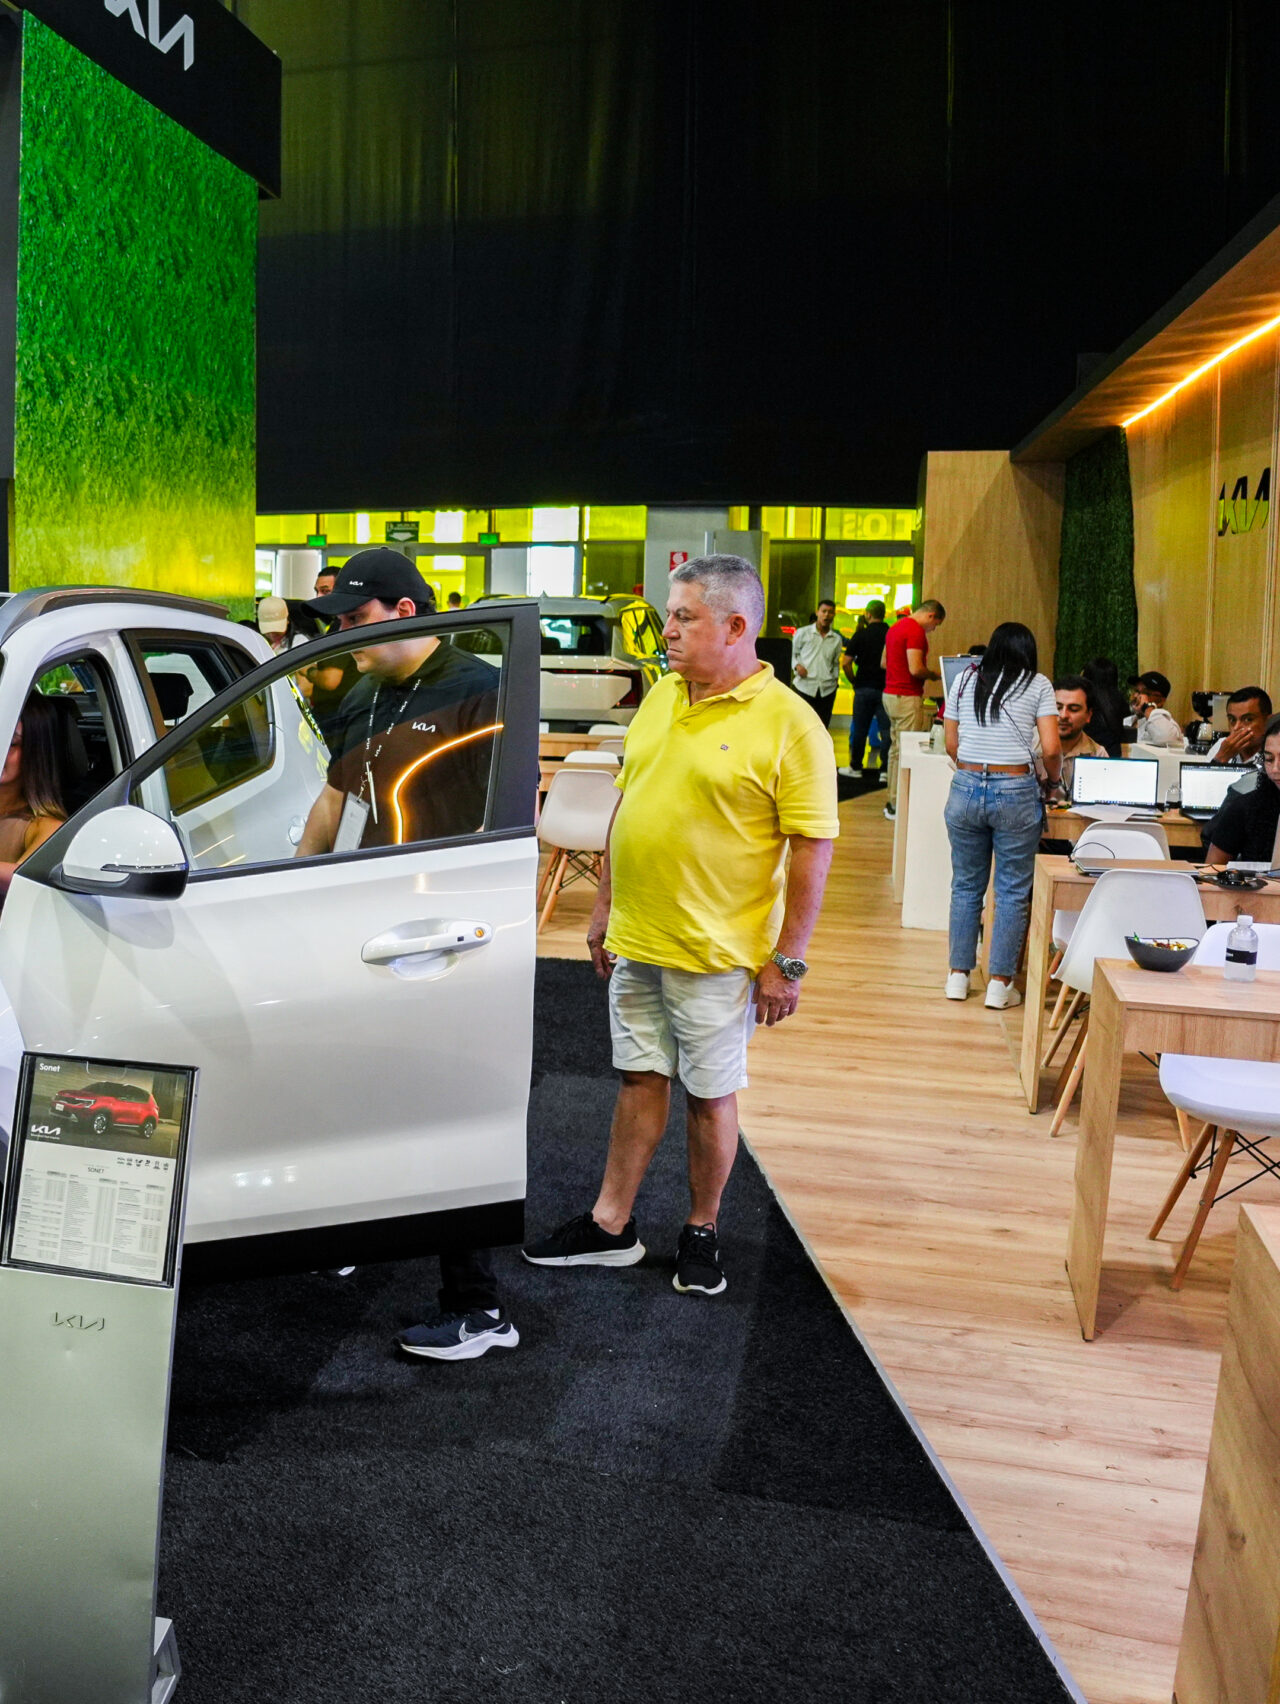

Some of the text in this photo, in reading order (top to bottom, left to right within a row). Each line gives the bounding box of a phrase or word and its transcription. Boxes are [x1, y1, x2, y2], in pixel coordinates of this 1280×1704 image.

[411, 721, 436, 733] KIA
[39, 1062, 61, 1073] Sonet
[31, 1124, 61, 1136] KIA
[53, 1312, 105, 1332] KIA
